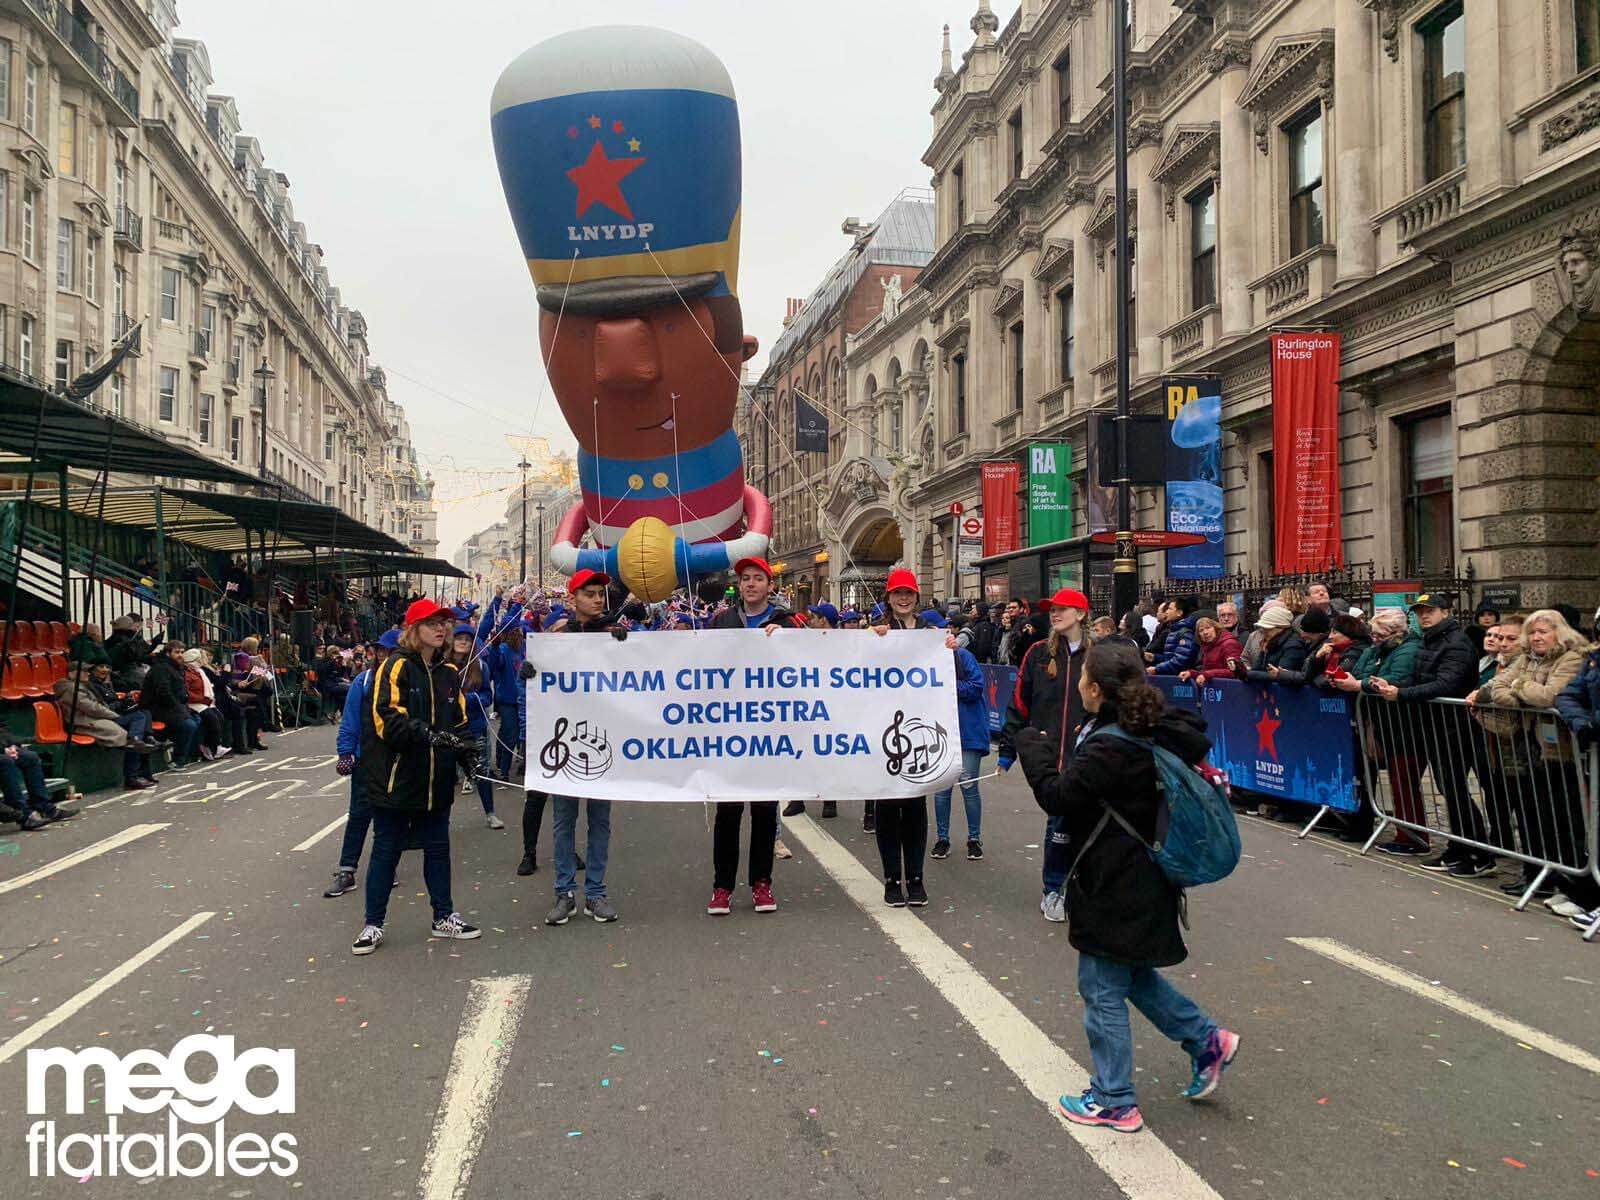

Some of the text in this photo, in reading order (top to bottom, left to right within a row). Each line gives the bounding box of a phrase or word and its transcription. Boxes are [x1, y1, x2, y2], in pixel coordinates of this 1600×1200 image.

[567, 223, 655, 241] LNYDP
[1277, 339, 1332, 350] Burlington
[1277, 349, 1313, 359] House
[1031, 448, 1057, 474] RA
[953, 503, 960, 514] L
[1032, 503, 1070, 511] architecture
[1170, 511, 1204, 524] Eco-
[1170, 523, 1220, 533] Visionaries
[541, 666, 944, 693] PUTNAM CITY HIGH SCHOOL
[662, 700, 830, 725] ORCHESTRA
[622, 732, 871, 761] OKLAHOMA, USA
[1255, 760, 1284, 776] LNYDP
